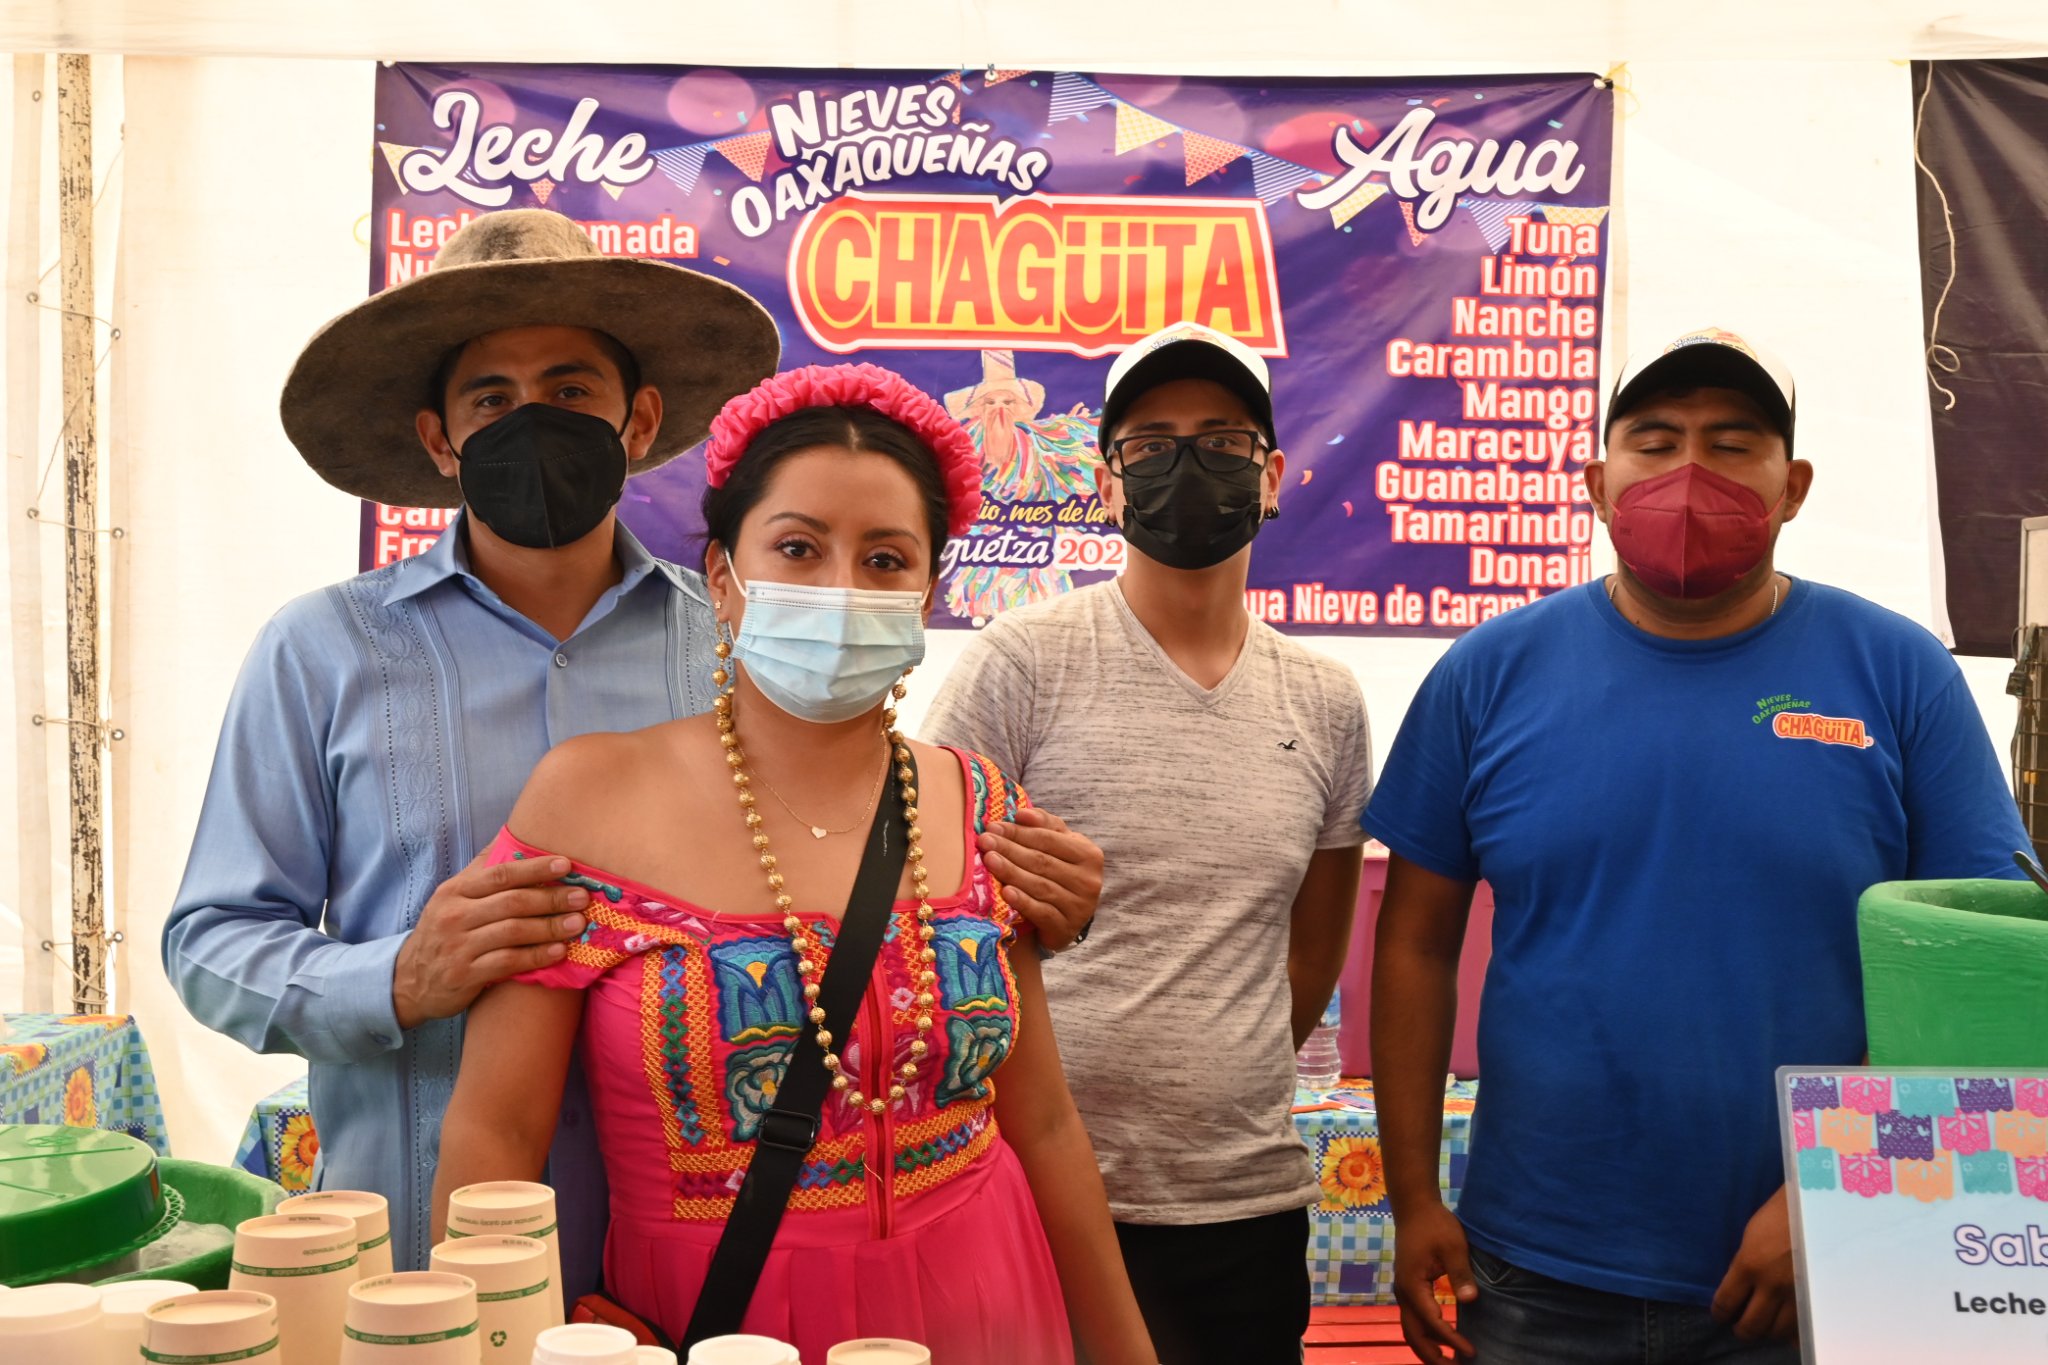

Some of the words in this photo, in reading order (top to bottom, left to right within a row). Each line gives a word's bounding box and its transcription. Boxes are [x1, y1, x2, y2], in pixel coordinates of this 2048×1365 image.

[771, 85, 956, 156] NIEVES
[402, 91, 654, 206] Leche
[1297, 107, 1586, 230] Agua
[730, 122, 1048, 237] OAXAQUEÑAS
[390, 211, 470, 249] Lec
[577, 217, 695, 255] mada
[1508, 217, 1598, 255] Tuna
[1483, 256, 1598, 296] Limón
[1454, 298, 1597, 337] Nanche
[1388, 340, 1595, 378] Carambola
[1465, 382, 1594, 430] Mango
[1401, 421, 1594, 471] Maracuyá
[1009, 504, 1054, 524] mes
[1057, 499, 1084, 523] de
[1085, 498, 1105, 524] la
[1389, 505, 1591, 544] Tamarindo
[938, 529, 1050, 579] guetza
[1058, 538, 1124, 565] 202
[1472, 547, 1591, 588] Donají
[1295, 584, 1377, 624] Nieve
[1386, 585, 1424, 624] de
[1751, 698, 1812, 725] OAXAQUEÑAS
[1756, 693, 1792, 710] NIEVES
[1953, 1223, 2048, 1267] Sab
[1953, 1291, 2047, 1316] Leche
